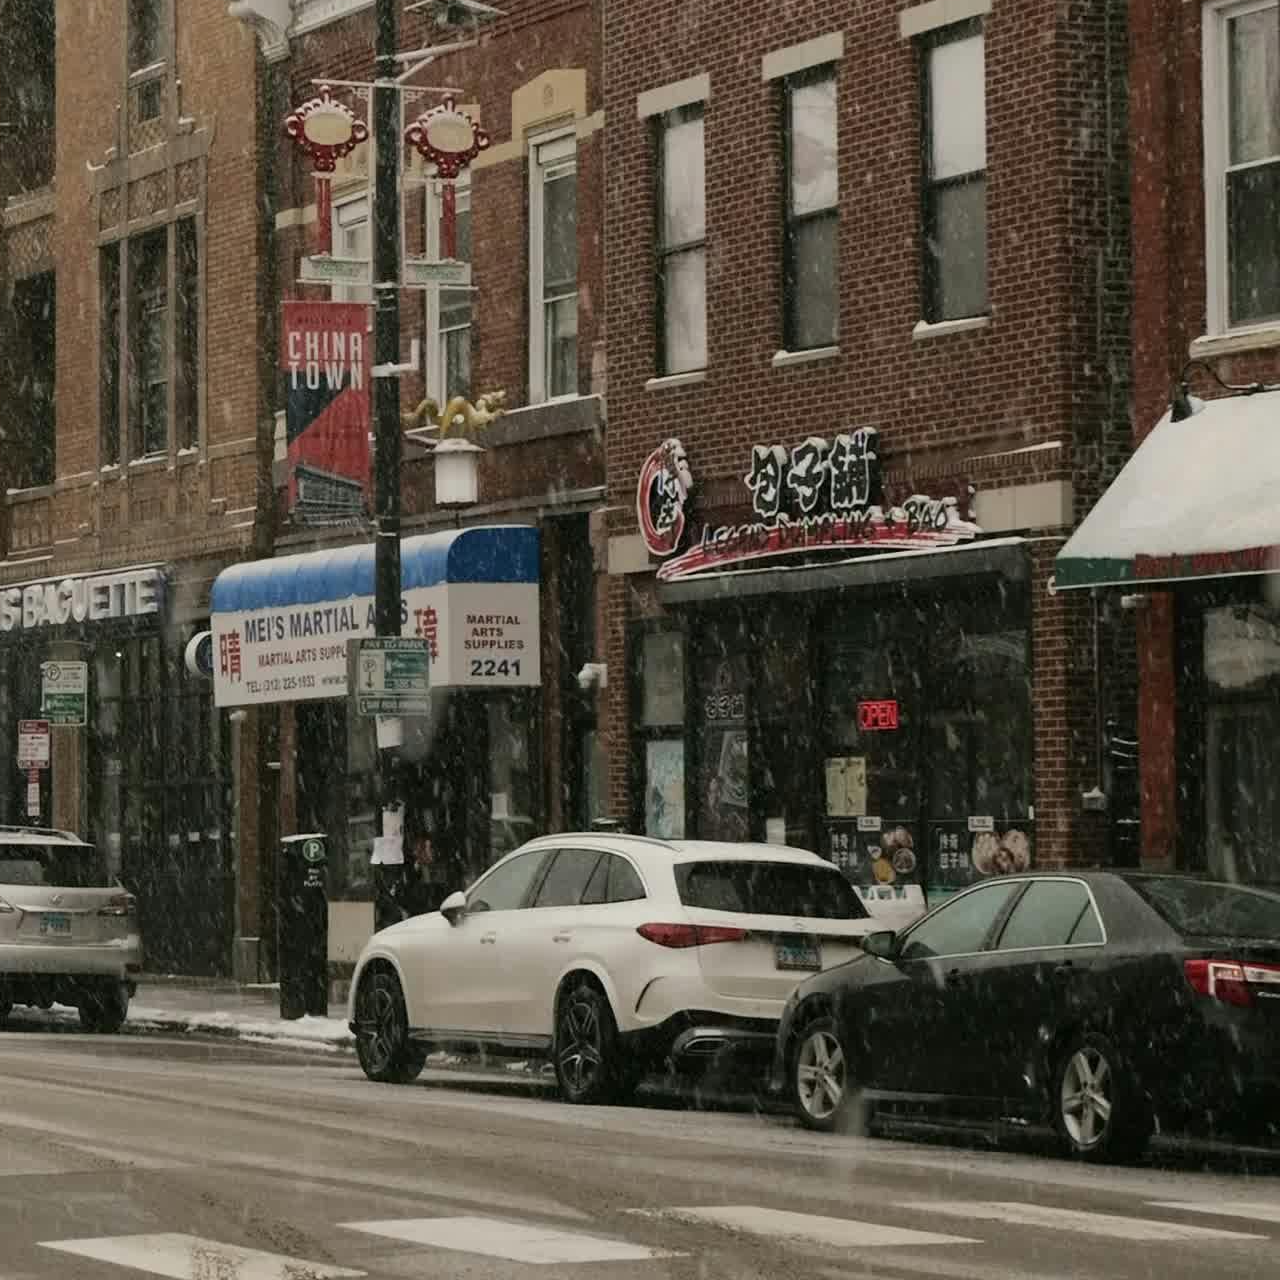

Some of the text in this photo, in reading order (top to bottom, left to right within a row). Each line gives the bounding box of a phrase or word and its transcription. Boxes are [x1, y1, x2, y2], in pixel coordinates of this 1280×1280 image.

[288, 331, 362, 360] CHINA
[288, 361, 362, 390] TOWN
[904, 498, 948, 532] BAO
[23, 569, 158, 628] BAGUETTE
[245, 599, 408, 643] MEI'S MARTIAL AS
[467, 614, 520, 625] MARTIAL
[472, 627, 504, 637] ARTS
[258, 645, 349, 668] MARTIAL ARTS SUPPL
[464, 639, 524, 650] SUPPLIES
[471, 659, 521, 676] 2241
[859, 703, 897, 727] OPEN
